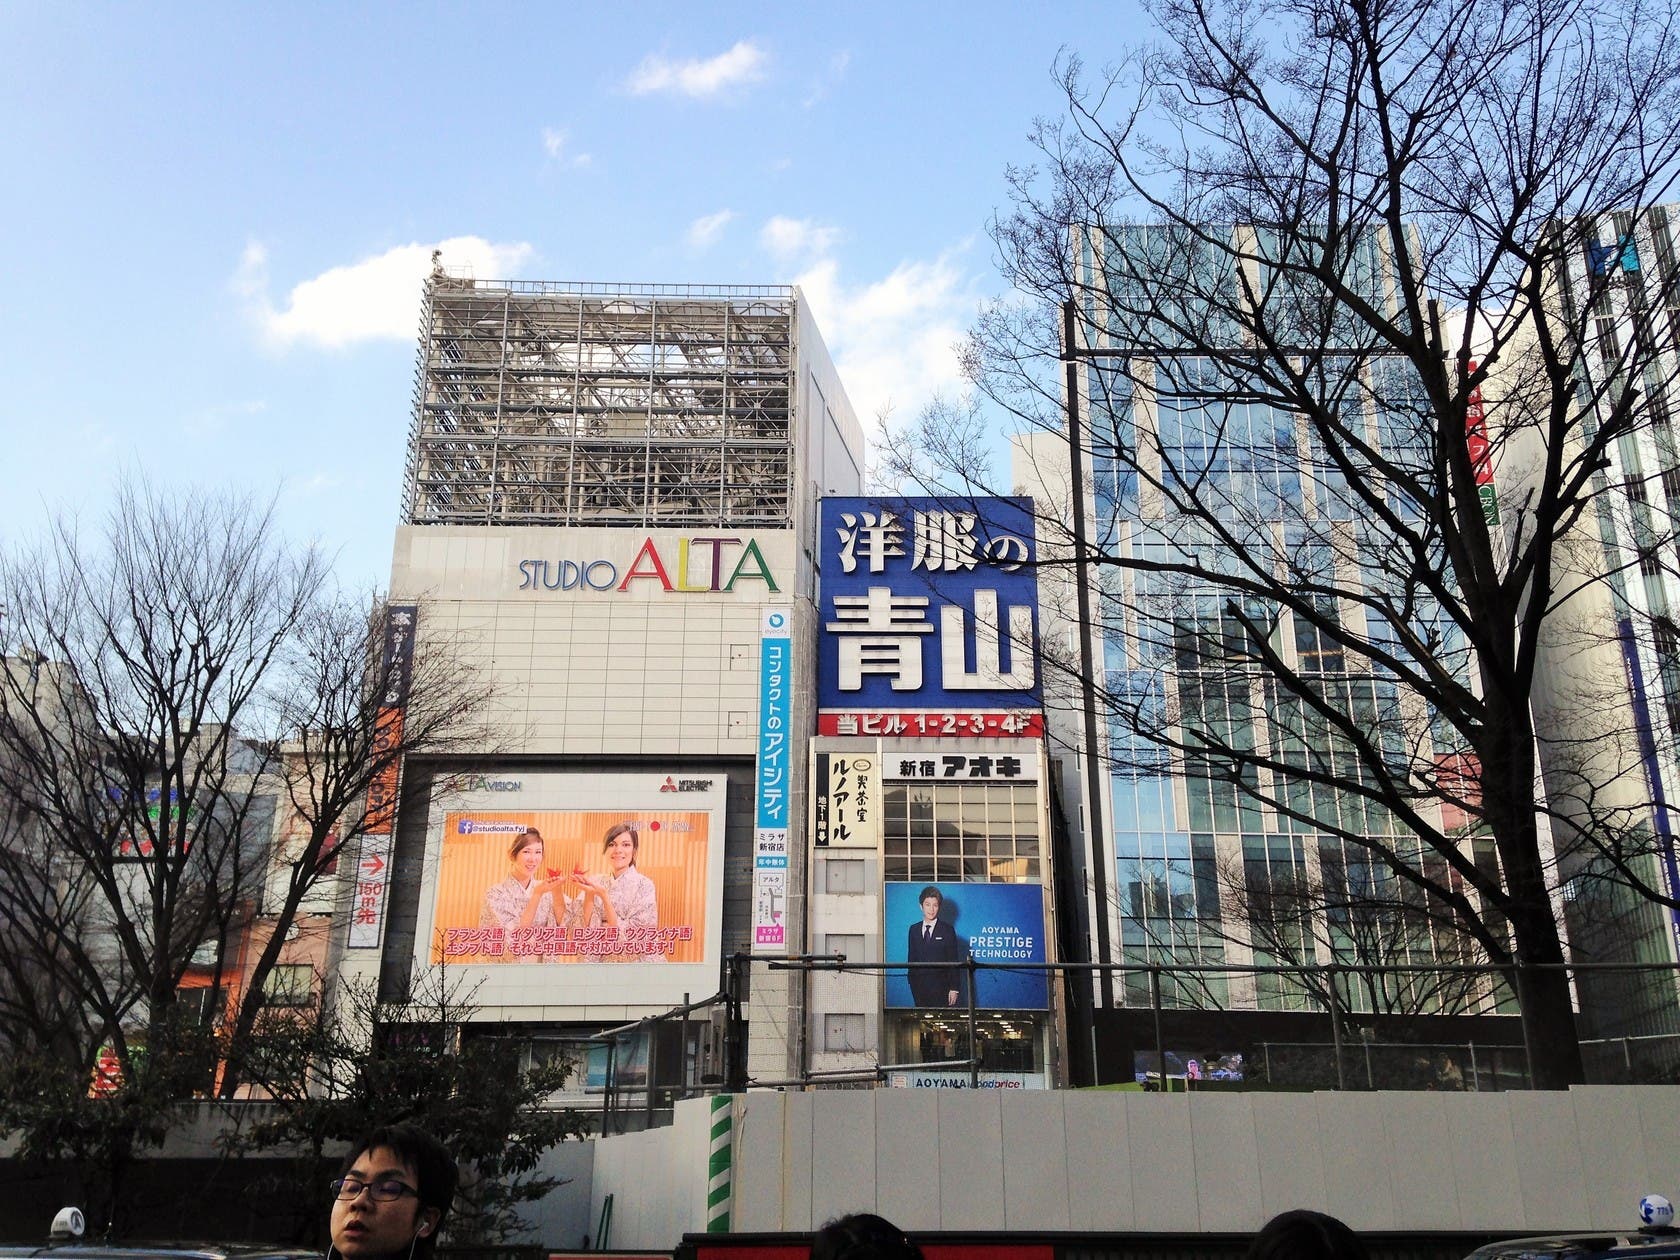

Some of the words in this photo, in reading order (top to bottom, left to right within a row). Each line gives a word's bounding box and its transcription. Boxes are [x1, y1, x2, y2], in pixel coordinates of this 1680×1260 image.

[836, 510, 1029, 573] 洋服の
[519, 560, 617, 591] STUDIO
[617, 537, 781, 592] ALTA
[826, 587, 1035, 691] 青山
[763, 646, 784, 820] コンタクトのアイシティ
[837, 714, 908, 735] 当ビル
[899, 755, 1021, 778] 新宿アオキ
[833, 758, 851, 841] ルノアール
[855, 774, 869, 823] 喫茶室
[759, 843, 785, 852] 新宿店
[446, 927, 504, 940] フランス語
[511, 927, 567, 940] イタリア語
[573, 927, 619, 940] ロシア語
[624, 927, 692, 940] ウクライナ語
[981, 926, 1020, 934] AOYAMA
[445, 941, 504, 956] エジプト語
[969, 936, 1033, 948] PRESTIGE
[969, 949, 1033, 958] TECHNOLOGY
[916, 1078, 967, 1089] AOYAMA
